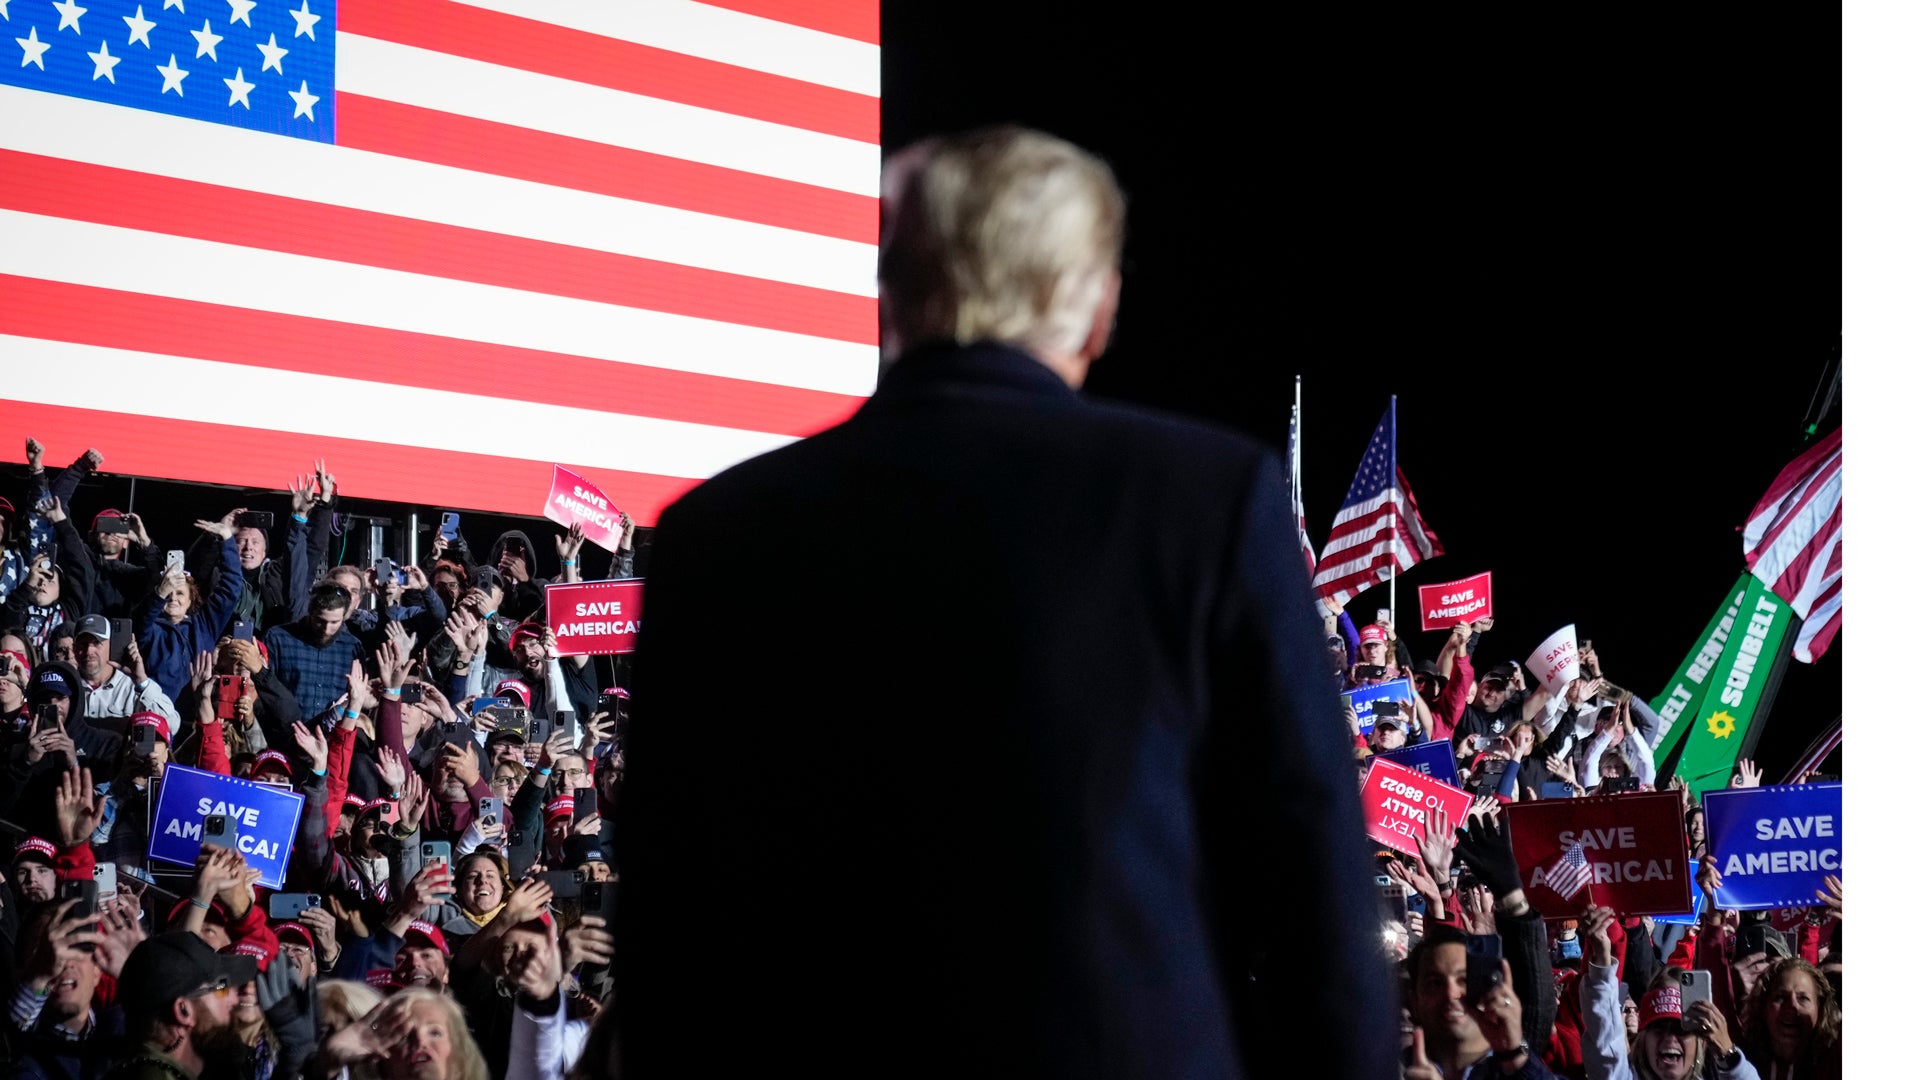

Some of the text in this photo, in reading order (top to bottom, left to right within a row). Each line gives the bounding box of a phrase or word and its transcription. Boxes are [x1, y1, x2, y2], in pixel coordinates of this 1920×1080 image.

[573, 485, 608, 511] SAVE
[554, 493, 619, 533] AMERICA!
[575, 601, 622, 617] SAVE
[1428, 597, 1486, 619] AMERICA!
[1441, 589, 1474, 605] SAVE
[556, 620, 642, 637] AMERICA!
[1545, 641, 1574, 664] SAVE
[1720, 595, 1778, 708] SUNBELT
[1380, 776, 1445, 813] TO 88022
[196, 797, 260, 827] SAVE
[1381, 797, 1425, 824] RALLY
[164, 818, 279, 860] AMICA!
[1378, 815, 1416, 839] TEXT
[1559, 827, 1637, 850] SAVE
[1755, 815, 1834, 841] SAVE
[1530, 859, 1674, 888] ARICA!
[1723, 848, 1842, 877] AMERIC
[1651, 995, 1681, 1006] AMERI
[1654, 1004, 1682, 1013] GREA
